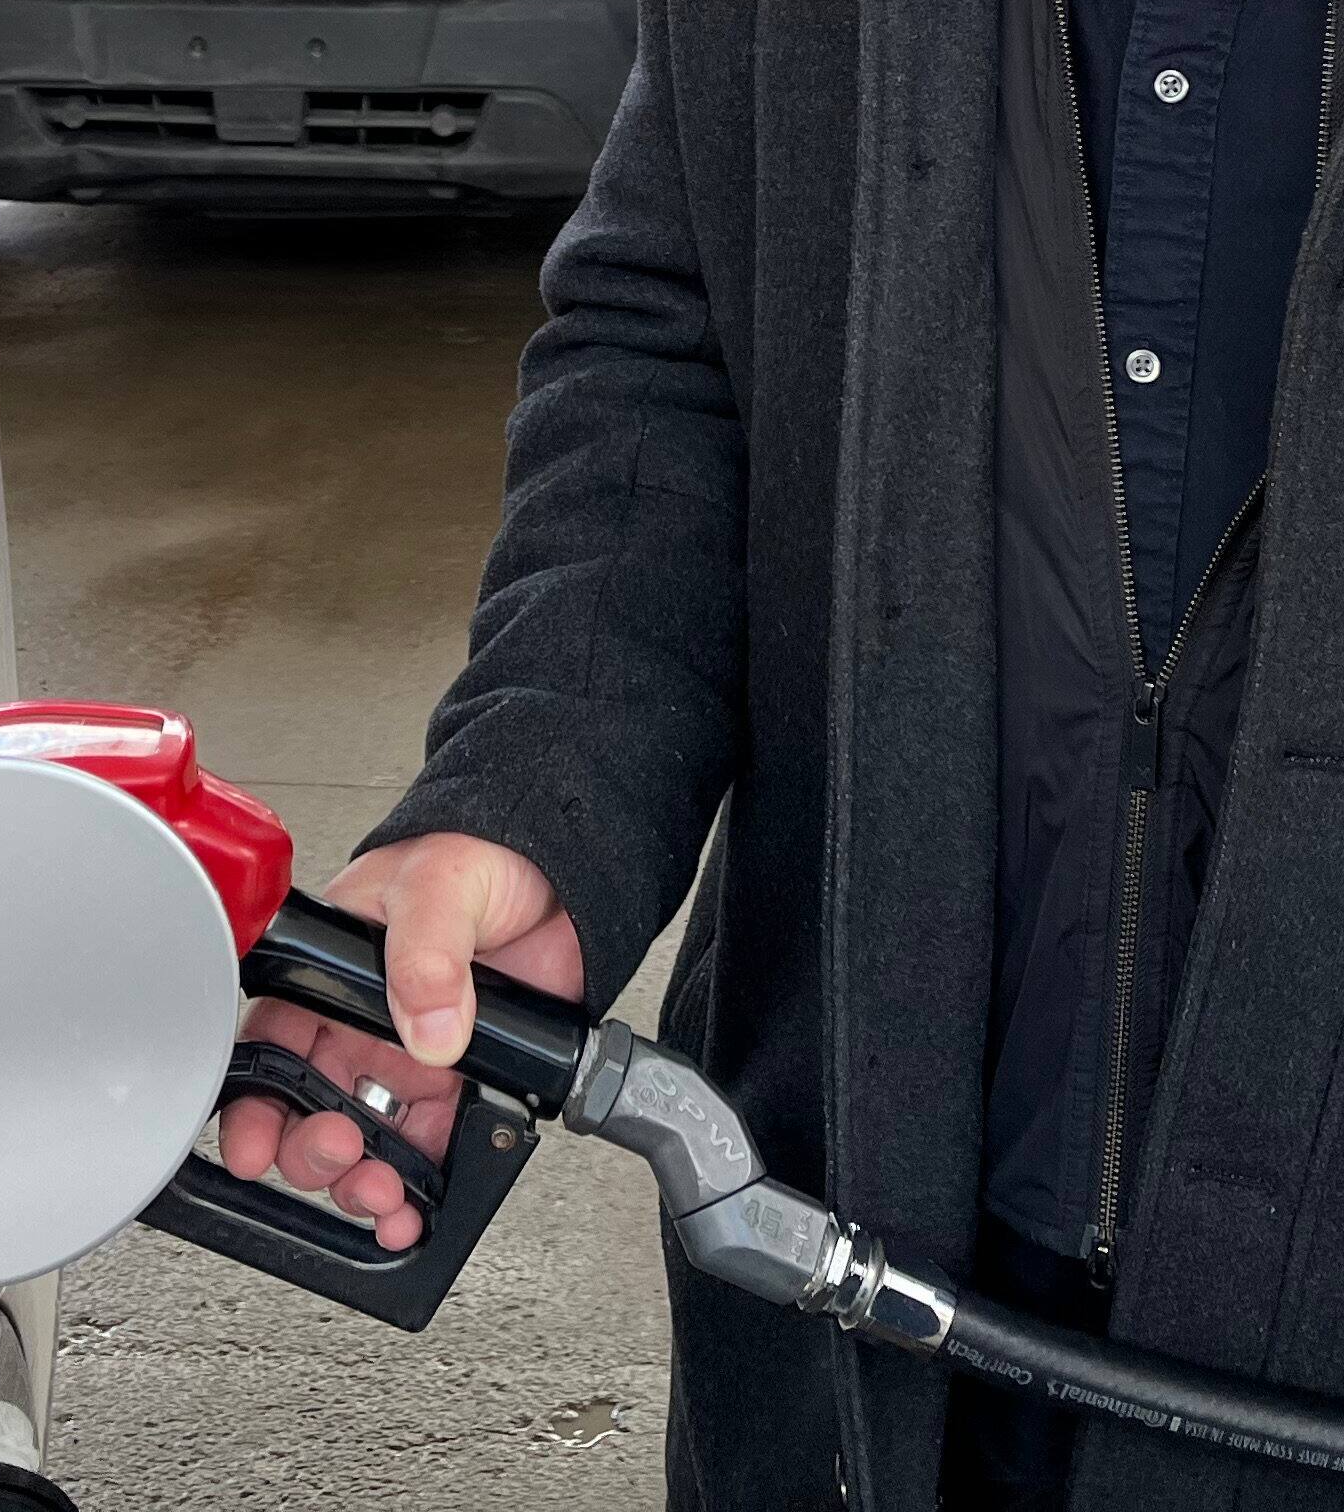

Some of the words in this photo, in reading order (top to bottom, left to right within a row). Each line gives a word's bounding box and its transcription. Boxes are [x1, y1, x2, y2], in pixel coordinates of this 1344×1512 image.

[647, 1064, 747, 1164] OPW
[742, 1198, 784, 1242] 45
[1059, 1382, 1169, 1428] Continental
[1182, 1421, 1209, 1438] USA
[1210, 1428, 1225, 1444] IN
[1225, 1432, 1262, 1452] MADE
[1296, 1449, 1331, 1468] HOSE
